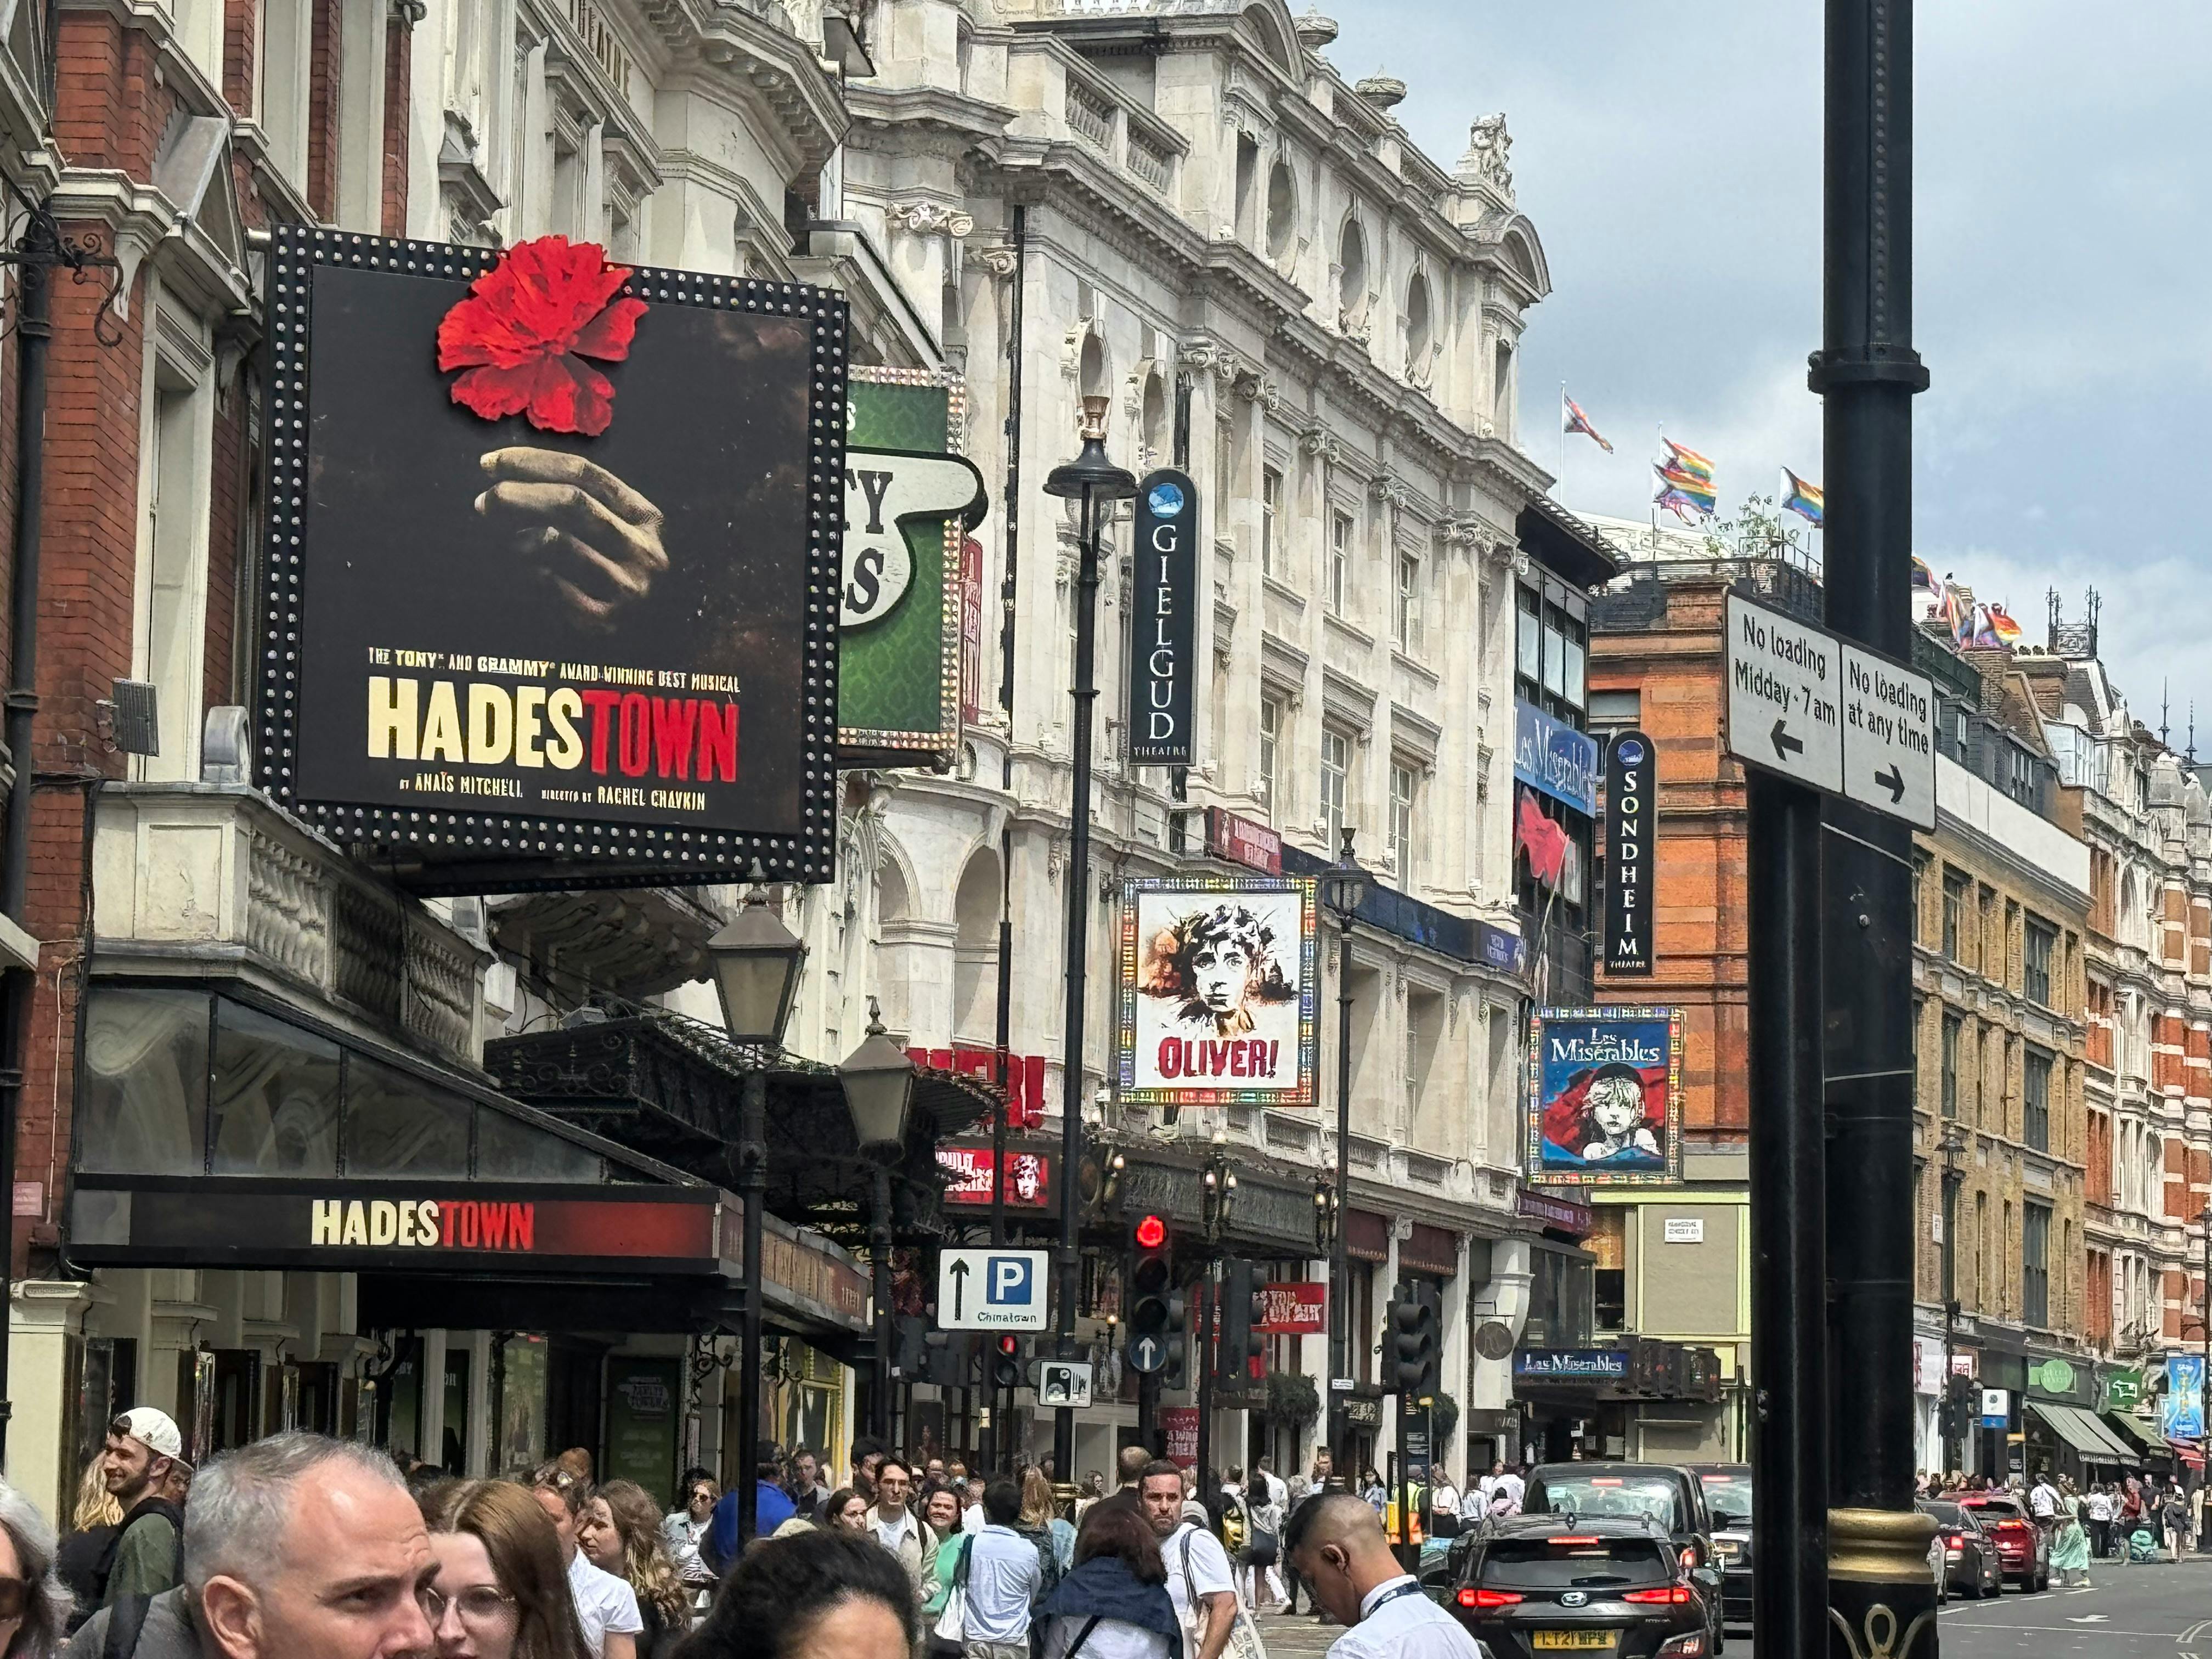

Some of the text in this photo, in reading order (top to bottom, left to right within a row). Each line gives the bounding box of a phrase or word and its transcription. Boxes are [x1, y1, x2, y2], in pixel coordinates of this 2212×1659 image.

[1149, 524, 1177, 740] GIELGUD
[1743, 613, 1826, 681] No loading
[691, 673, 741, 693] MUSICAL
[1735, 658, 1790, 713] Midday
[1849, 659, 1926, 723] No loading
[368, 676, 738, 782] HADESTOWN
[1848, 699, 1929, 755] at any time
[461, 777, 523, 798] MITCHELL
[598, 786, 646, 807] RACHEL
[651, 789, 706, 811] CHAVKIN
[1618, 770, 1639, 956] SONDHEIM
[1158, 1036, 1279, 1079] OLIVER!
[1590, 1028, 1617, 1045] Les
[311, 1199, 534, 1250] HADESTOWN
[978, 1311, 1037, 1324] Chinatown
